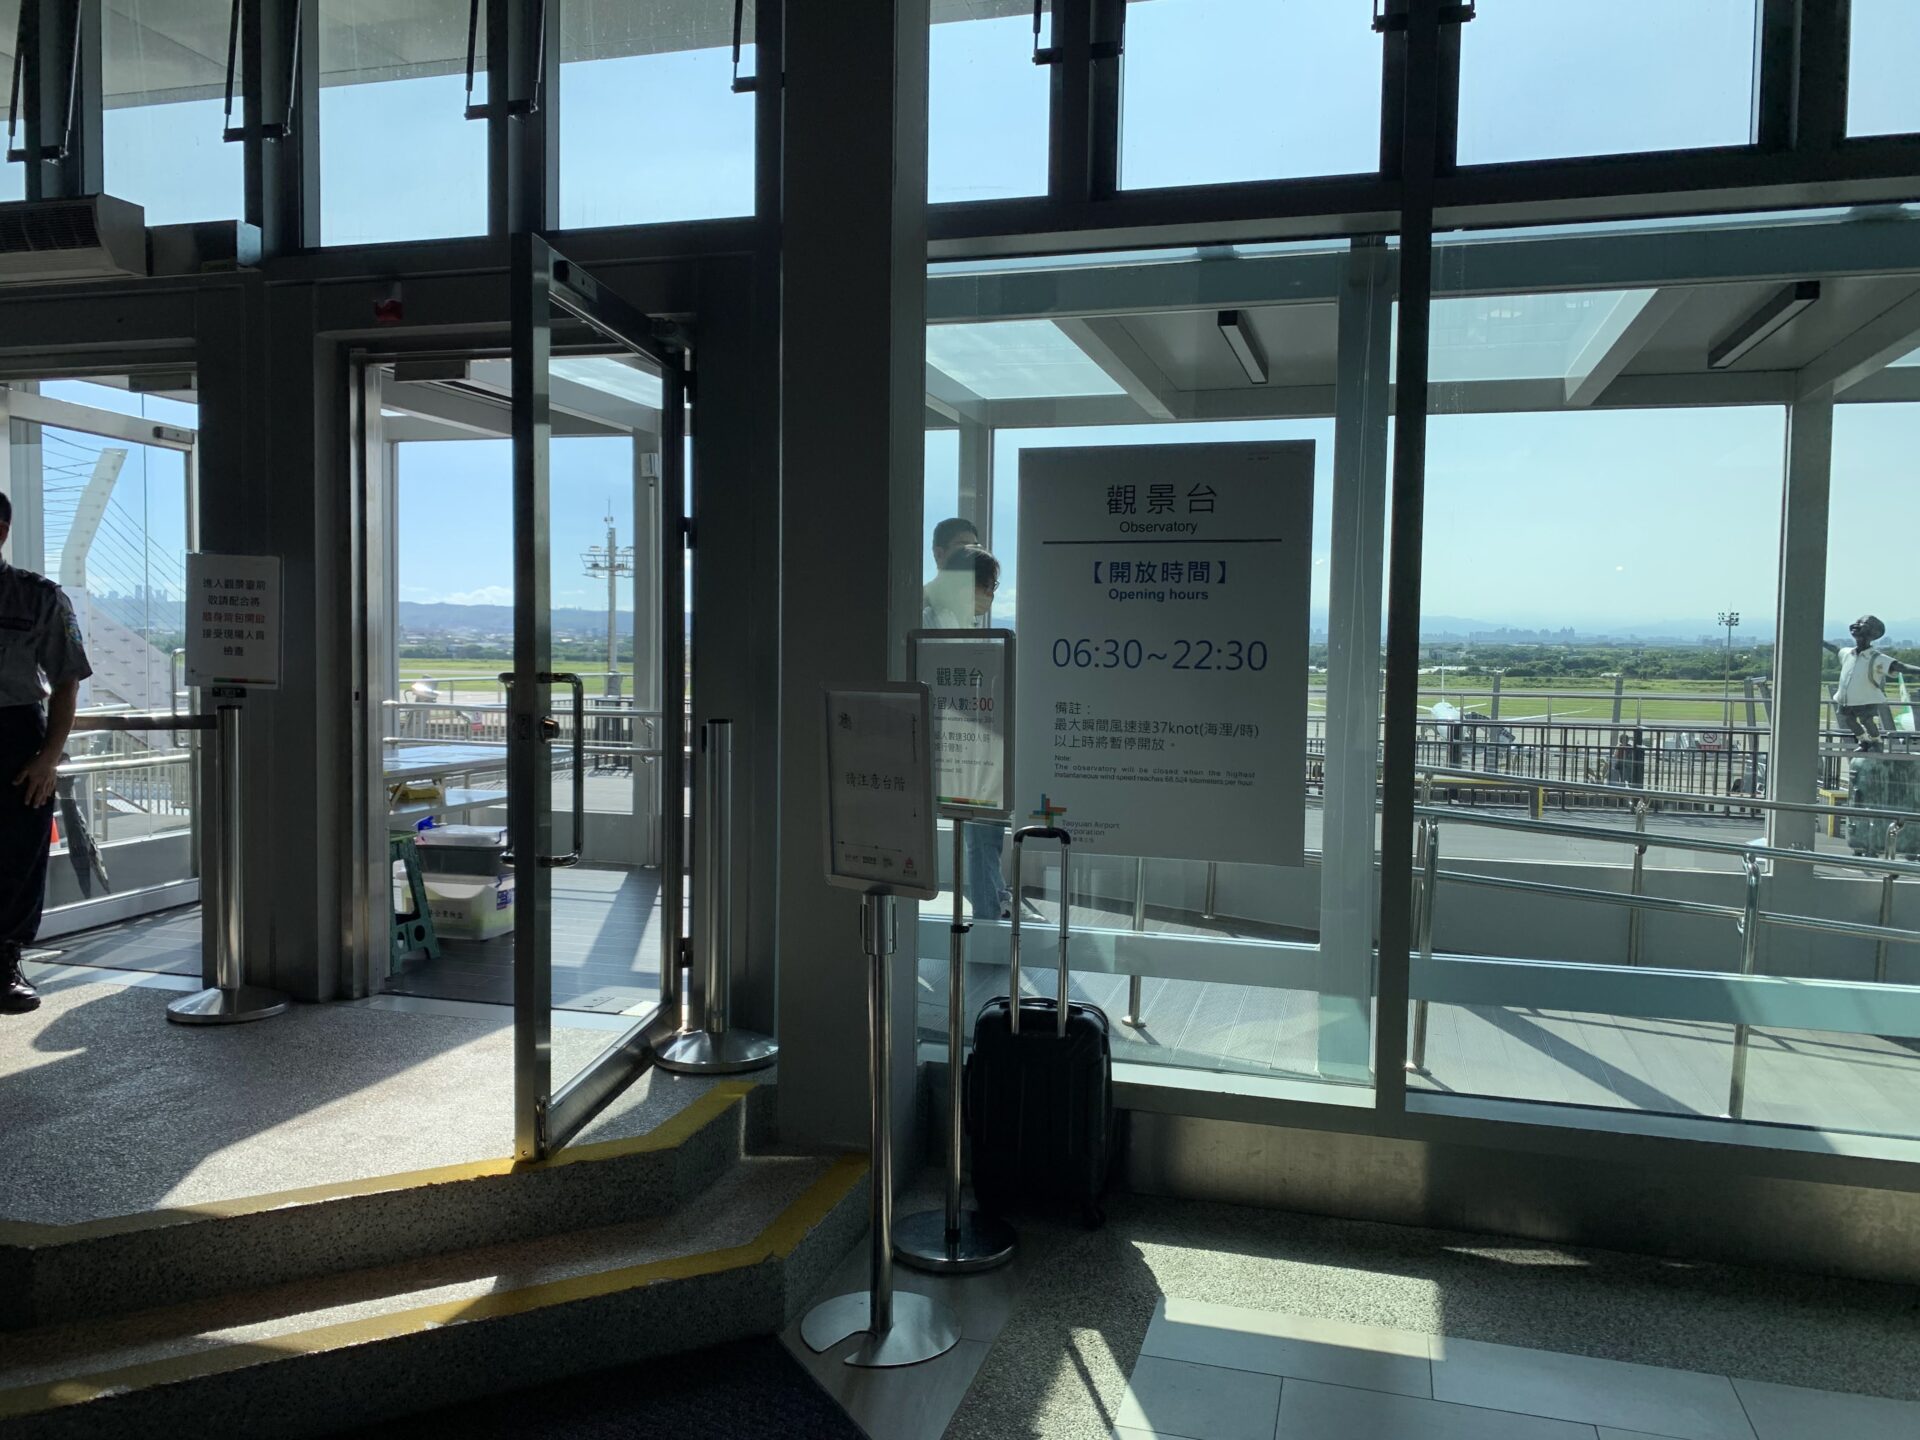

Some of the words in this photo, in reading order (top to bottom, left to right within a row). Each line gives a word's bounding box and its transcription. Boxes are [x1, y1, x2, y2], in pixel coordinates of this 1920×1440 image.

[1106, 482, 1217, 515] 觀景台
[1119, 520, 1198, 535] Observatory
[1093, 560, 1226, 584] 【開放時間】
[1108, 588, 1165, 602] Opening
[1169, 588, 1209, 600] hours
[1052, 638, 1268, 671] 06:30~22:30
[936, 666, 984, 688] 觀景台
[933, 696, 994, 712] 留人數:300
[1072, 764, 1117, 773] observatory
[846, 771, 905, 792] 請注意台階
[1094, 821, 1120, 830] Airport
